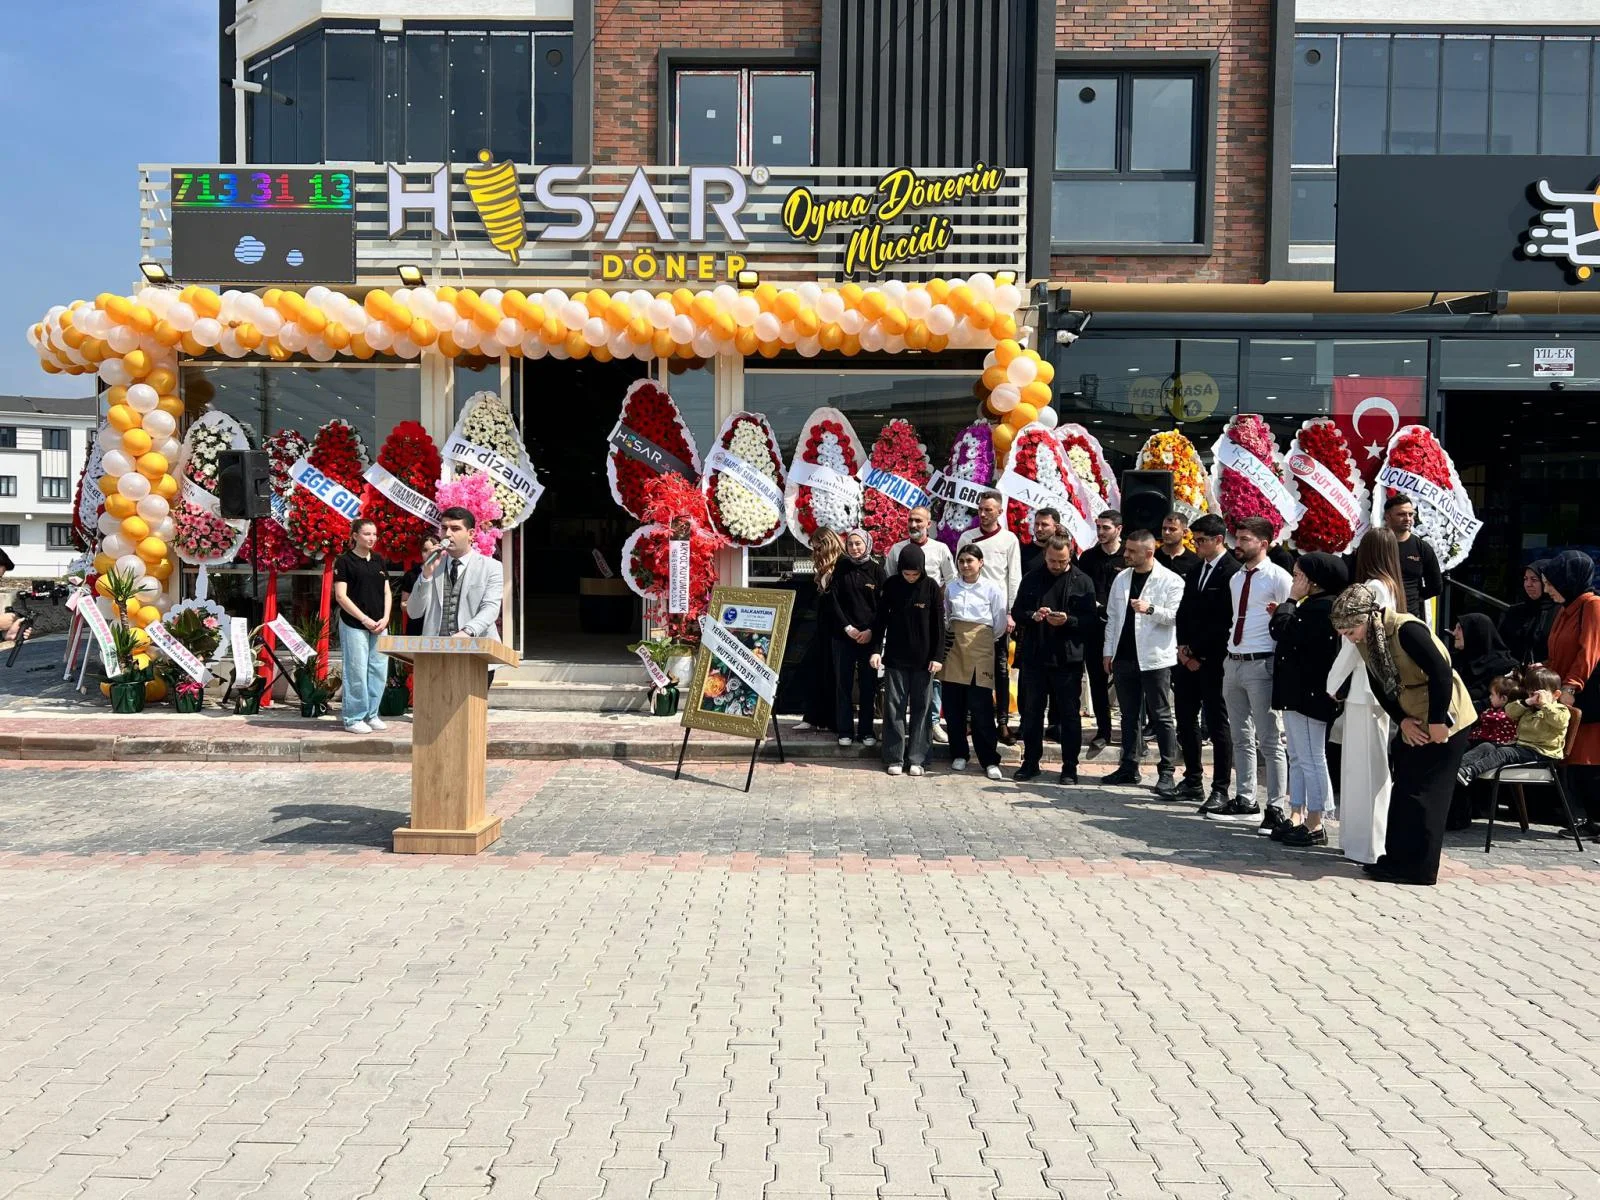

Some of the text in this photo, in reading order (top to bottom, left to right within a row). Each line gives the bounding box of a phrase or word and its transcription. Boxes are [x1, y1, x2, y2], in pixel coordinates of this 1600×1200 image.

[173, 172, 352, 204] 713 31 13
[783, 161, 1003, 243] Oyma Dönerin
[844, 215, 951, 276] Mucidi
[298, 466, 335, 498] EGE
[451, 442, 475, 457] mr
[476, 451, 531, 493] dizayn
[865, 468, 909, 501] KAPTAN
[1379, 465, 1439, 501] ÜÇÜZLER
[678, 542, 689, 613] AKYOL KUYUMCULUK
[711, 624, 741, 652] YENİŞEKER
[716, 644, 737, 666] MUTFAK
